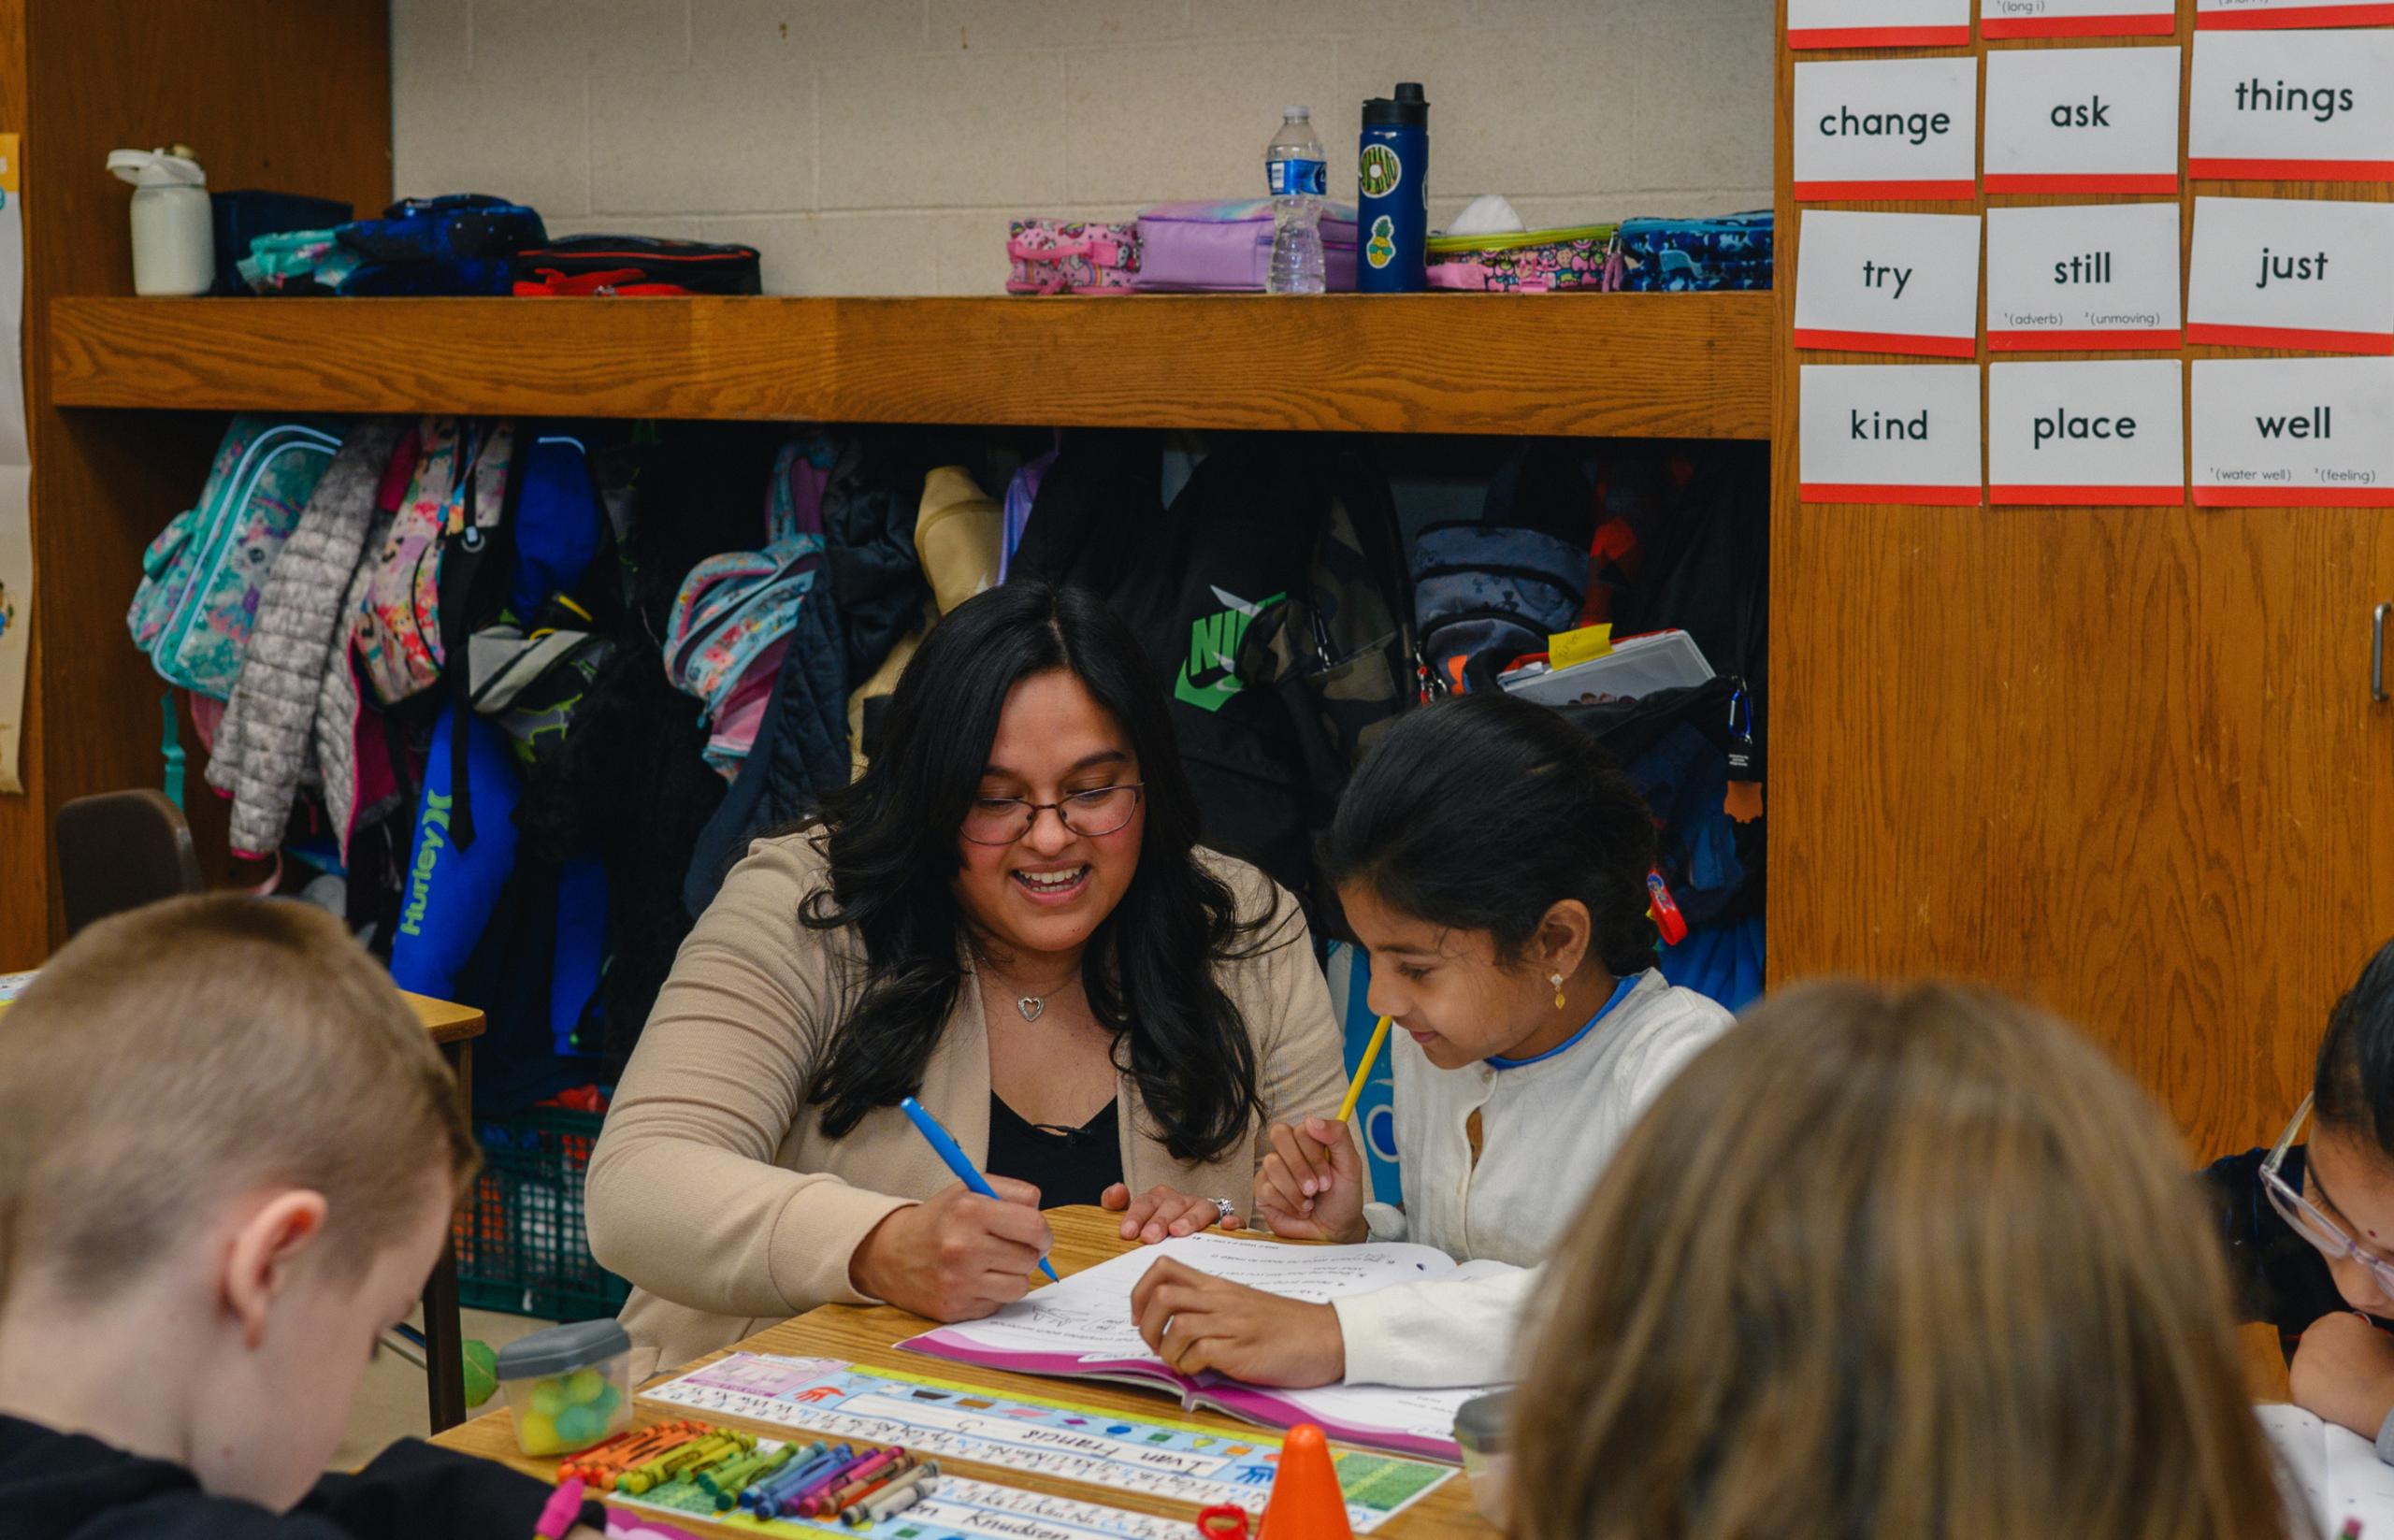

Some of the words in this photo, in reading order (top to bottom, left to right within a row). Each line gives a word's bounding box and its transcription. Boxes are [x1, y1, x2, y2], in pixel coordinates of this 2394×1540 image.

[2050, 95, 2111, 127] ask
[2235, 79, 2354, 122] things
[1819, 106, 1951, 145] change
[1862, 260, 1913, 300] try
[2054, 252, 2112, 284] still
[2256, 247, 2329, 289] just
[1851, 409, 1928, 441] kind
[2033, 408, 2137, 451] place
[2255, 406, 2331, 439] well
[2262, 468, 2291, 482] well)
[400, 827, 444, 936] Hurley
[1021, 1429, 1121, 1459] Francis
[1140, 1451, 1214, 1475] Ivan
